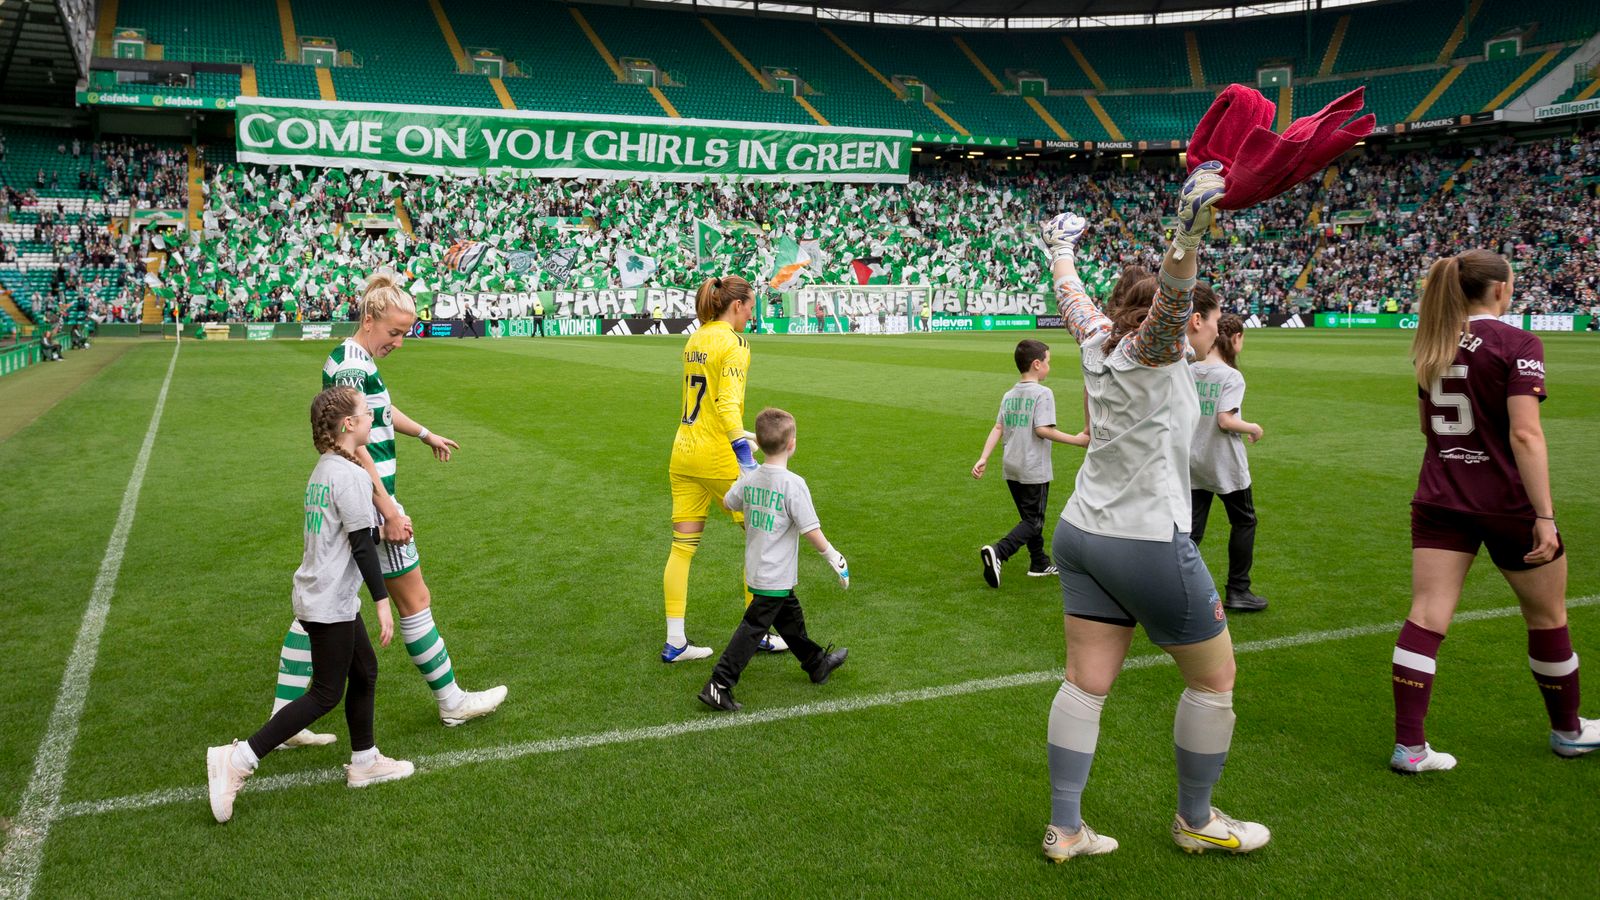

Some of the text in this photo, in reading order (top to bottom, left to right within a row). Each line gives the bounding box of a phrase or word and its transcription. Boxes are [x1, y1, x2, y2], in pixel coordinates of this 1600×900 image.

[100, 93, 140, 103] dafabet
[165, 96, 204, 106] dafabet
[1538, 101, 1600, 117] intelligent
[1411, 117, 1455, 130] MAGNERS
[239, 113, 901, 171] COME ON YOU GHIRLS IN GREEN
[1046, 140, 1079, 149] MAGNERS
[1097, 141, 1133, 150] MAGNERS
[434, 291, 543, 320] DREAM
[555, 289, 638, 316] THAT
[932, 289, 961, 312] IS
[966, 290, 1048, 315] YOURS
[559, 319, 597, 336] WOMEN
[932, 316, 973, 327] eleven
[681, 374, 708, 427] 17
[1430, 364, 1476, 436] 5
